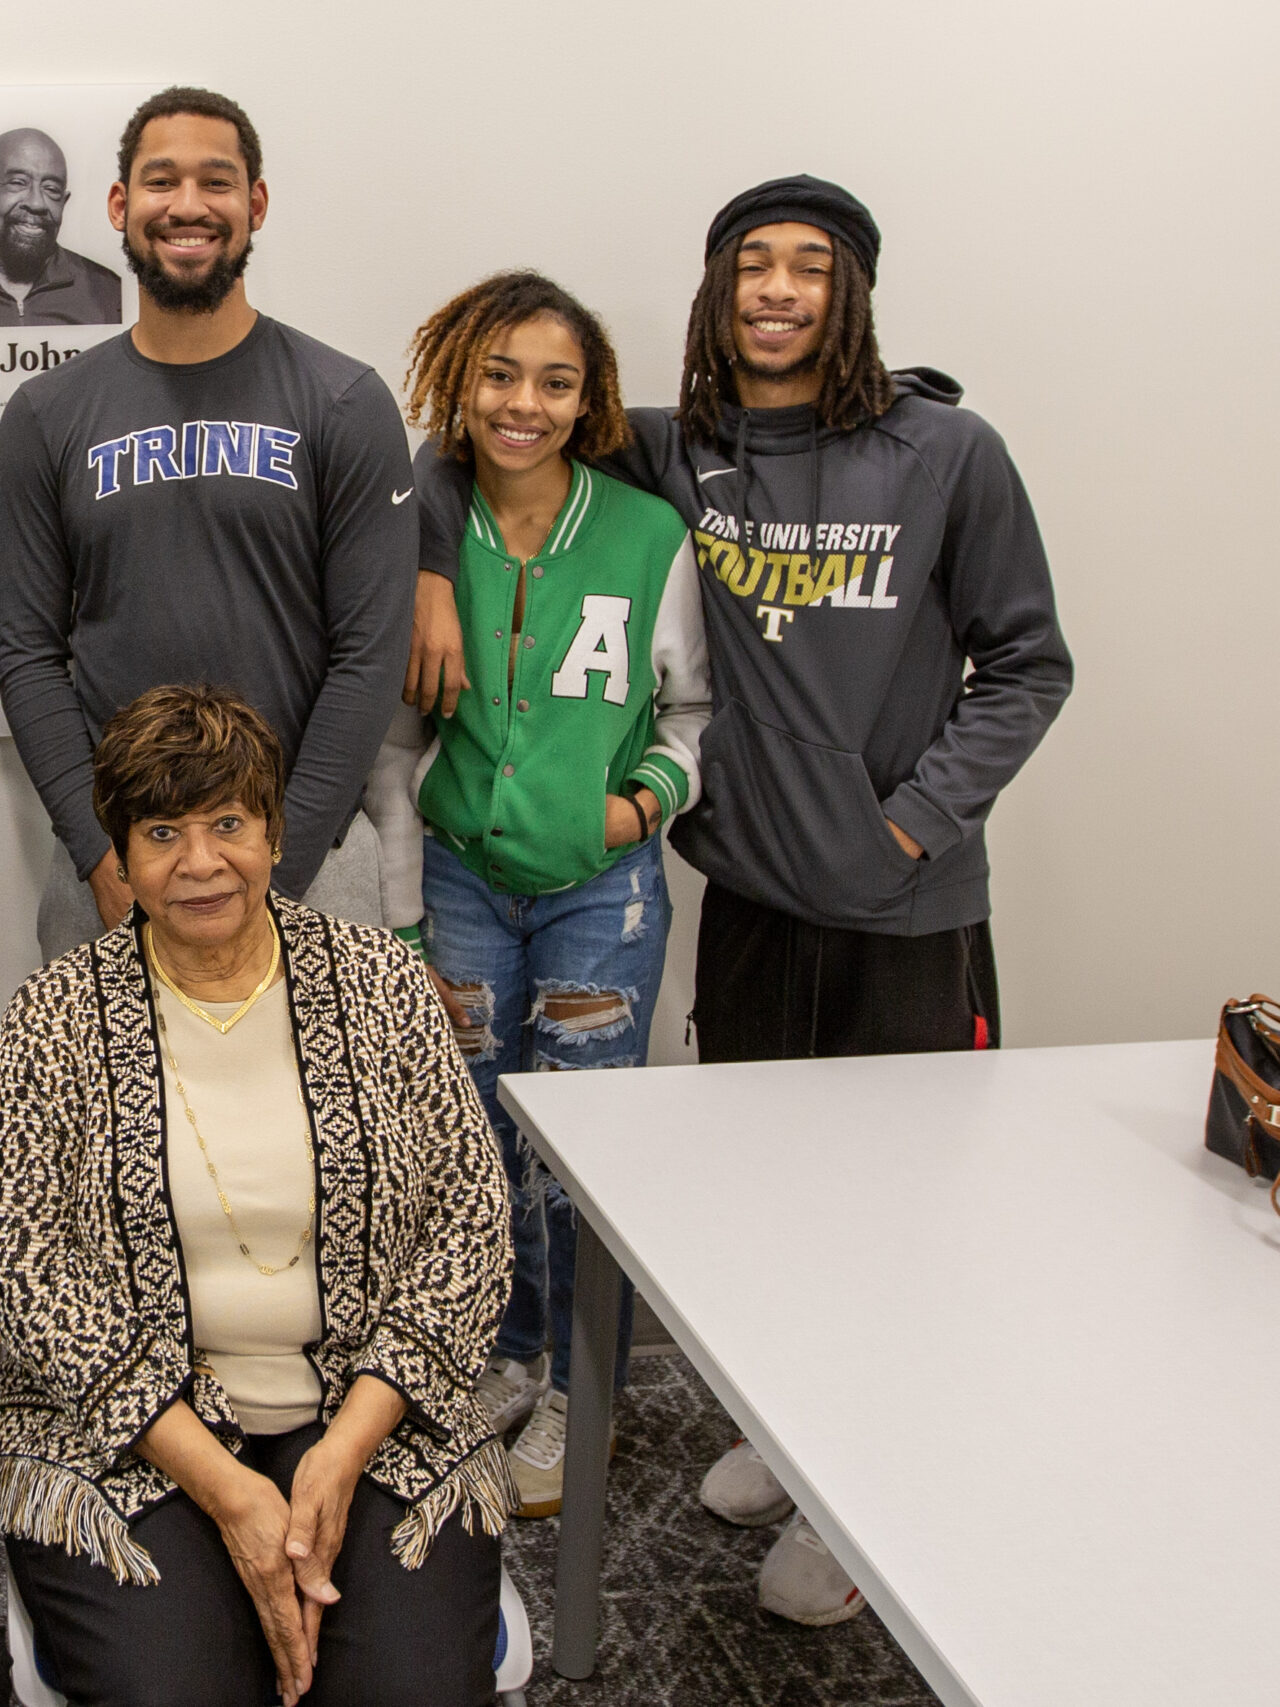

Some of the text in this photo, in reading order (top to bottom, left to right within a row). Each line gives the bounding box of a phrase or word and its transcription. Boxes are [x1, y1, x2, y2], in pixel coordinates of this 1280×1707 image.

[88, 420, 300, 500] TRINE
[694, 530, 898, 609] FOOTBALL
[760, 522, 901, 551] UNIVERSITY
[550, 593, 632, 707] A
[756, 604, 794, 643] T
